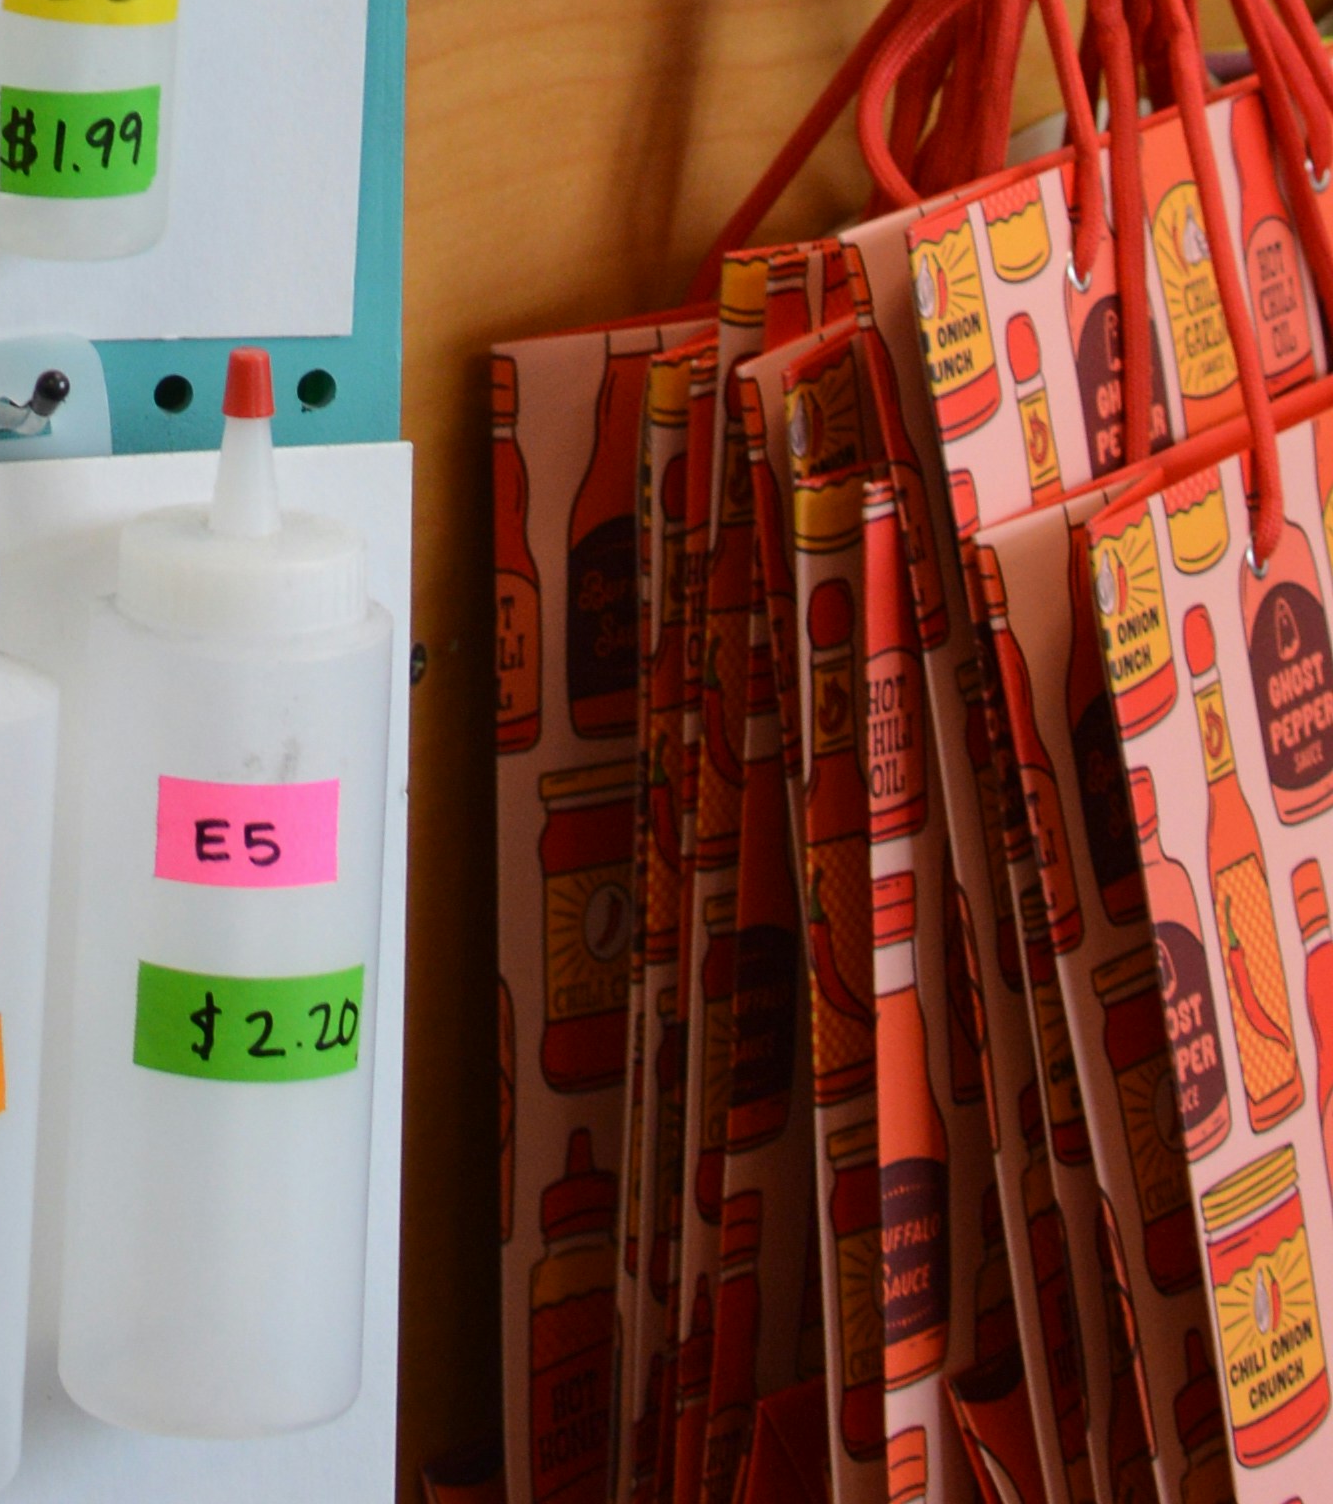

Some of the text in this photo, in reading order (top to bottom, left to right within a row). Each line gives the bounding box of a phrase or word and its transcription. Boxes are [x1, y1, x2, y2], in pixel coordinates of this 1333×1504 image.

[0, 105, 144, 175] $1.99
[936, 311, 983, 349] ONION
[1117, 607, 1159, 645] ONION
[1267, 651, 1324, 708] GHOST
[193, 817, 283, 868] E5
[1229, 1317, 1315, 1388] CHILI ONION
[1248, 1356, 1306, 1411] CRUNCH
